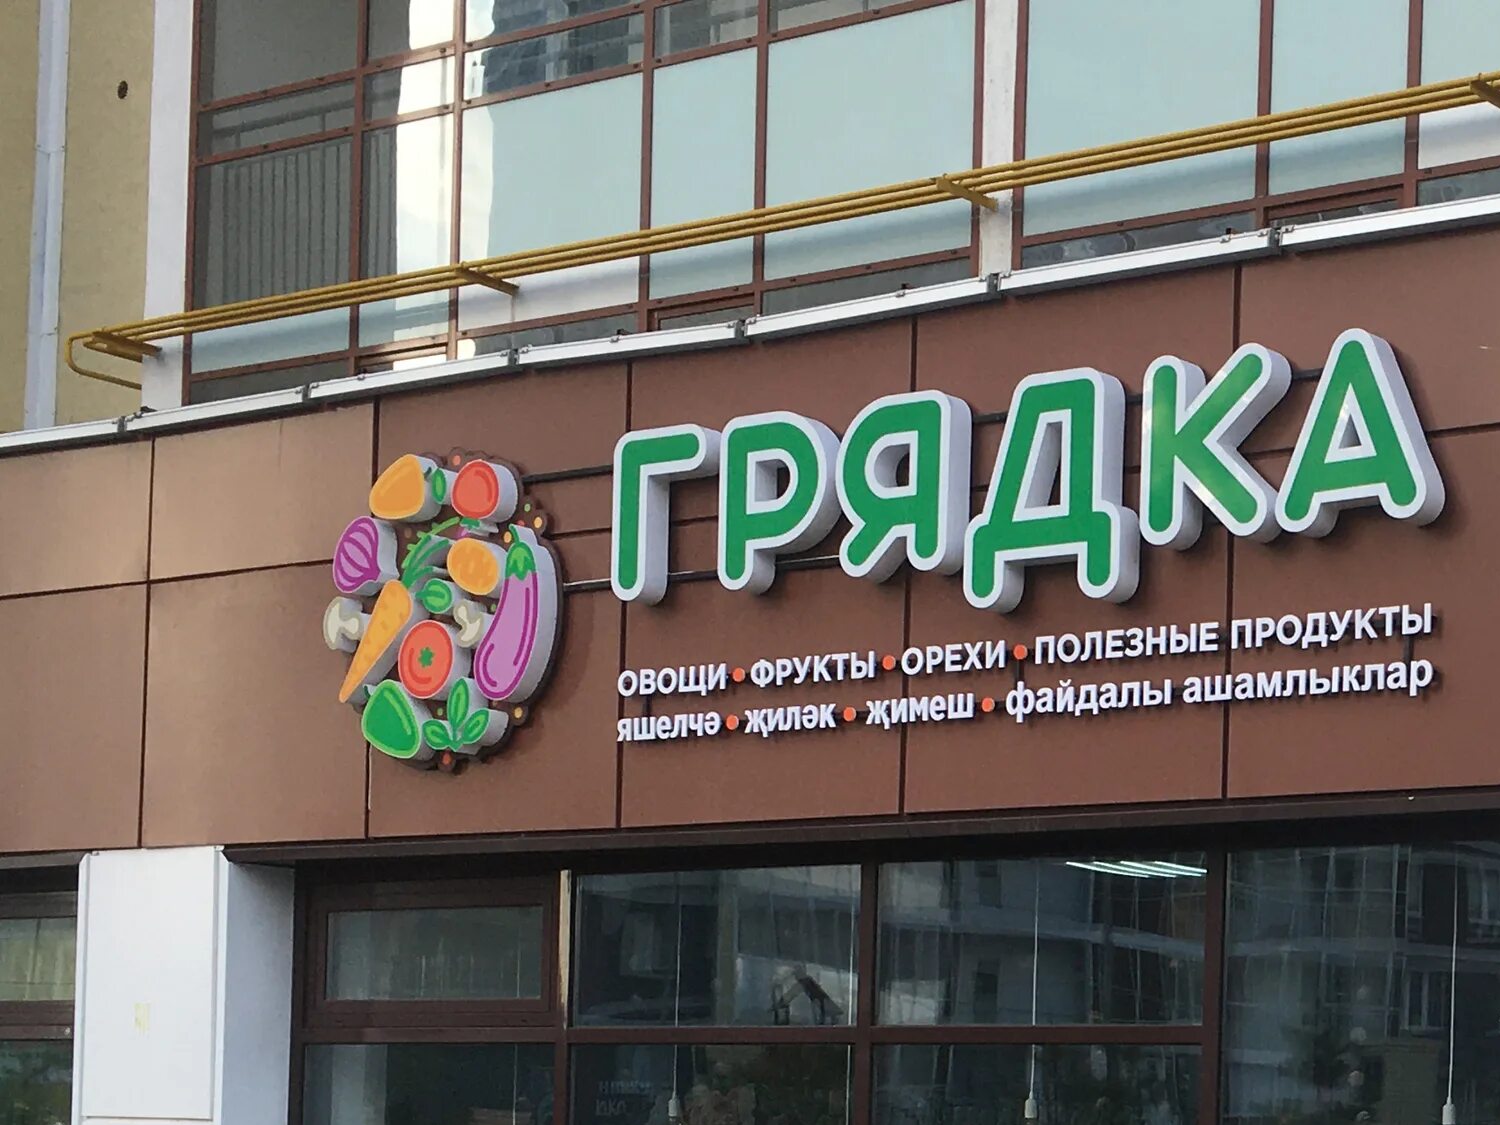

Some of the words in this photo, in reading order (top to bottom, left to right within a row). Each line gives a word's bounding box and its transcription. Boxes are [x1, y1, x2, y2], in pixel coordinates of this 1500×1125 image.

[612, 328, 1443, 611] ГРЯДКА
[617, 663, 727, 697] ОВОЩИ
[750, 651, 875, 688] ФРУКТЫ
[901, 640, 1005, 675] ОРЕХИ
[1035, 622, 1219, 664] ПОЛЕЗНЫЕ
[1231, 603, 1432, 650] ПРОДУКТЫ
[617, 711, 721, 742] яшелчә
[745, 704, 836, 737] җиләк
[866, 693, 974, 729] җимеш
[1005, 679, 1171, 723] файдалы
[1182, 659, 1433, 703] ашамлыклар
